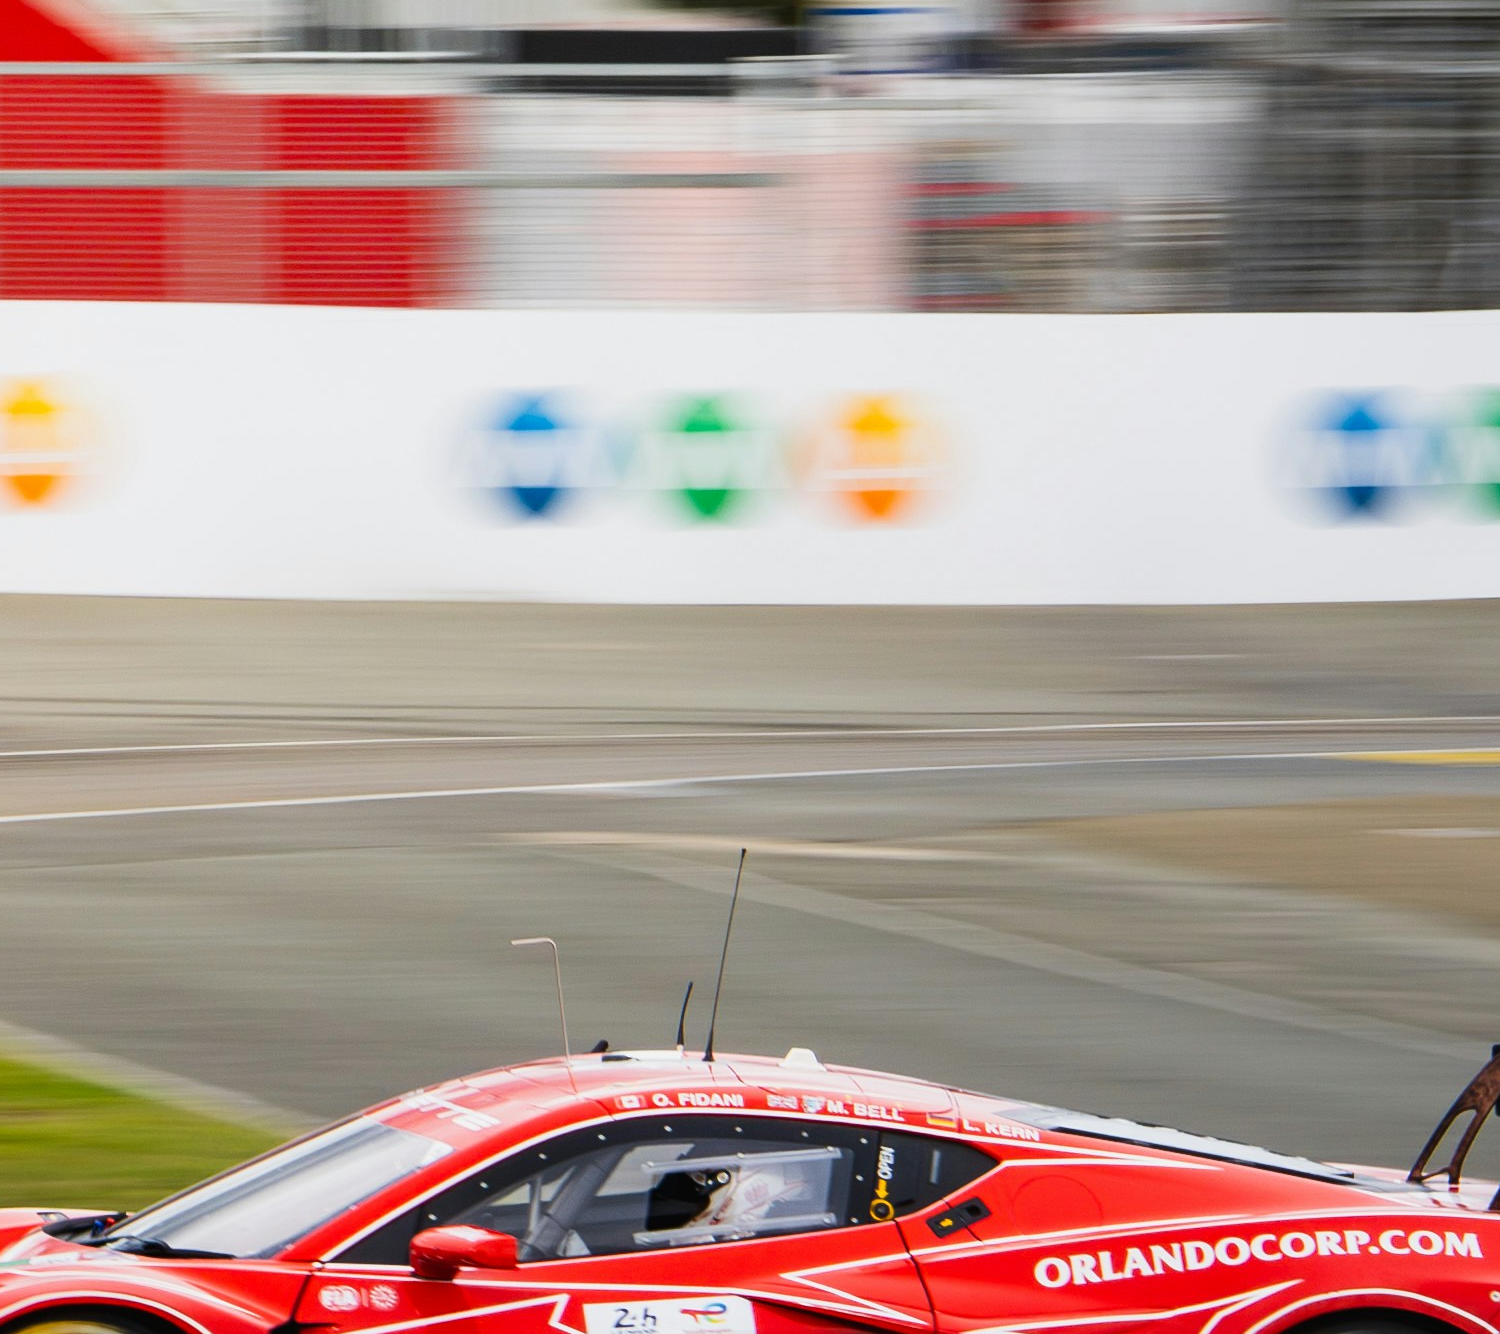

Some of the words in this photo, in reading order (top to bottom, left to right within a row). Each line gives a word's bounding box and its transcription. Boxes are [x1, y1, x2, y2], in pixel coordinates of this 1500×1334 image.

[652, 1093, 675, 1107] O.
[677, 1093, 744, 1107] FIDANI
[826, 1100, 849, 1116] M.
[853, 1103, 905, 1122] BELL
[962, 1119, 980, 1133] L.
[985, 1123, 1040, 1142] KERN
[877, 1145, 896, 1180] OPEN
[1033, 1228, 1484, 1289] ORLANDOCORP.COM
